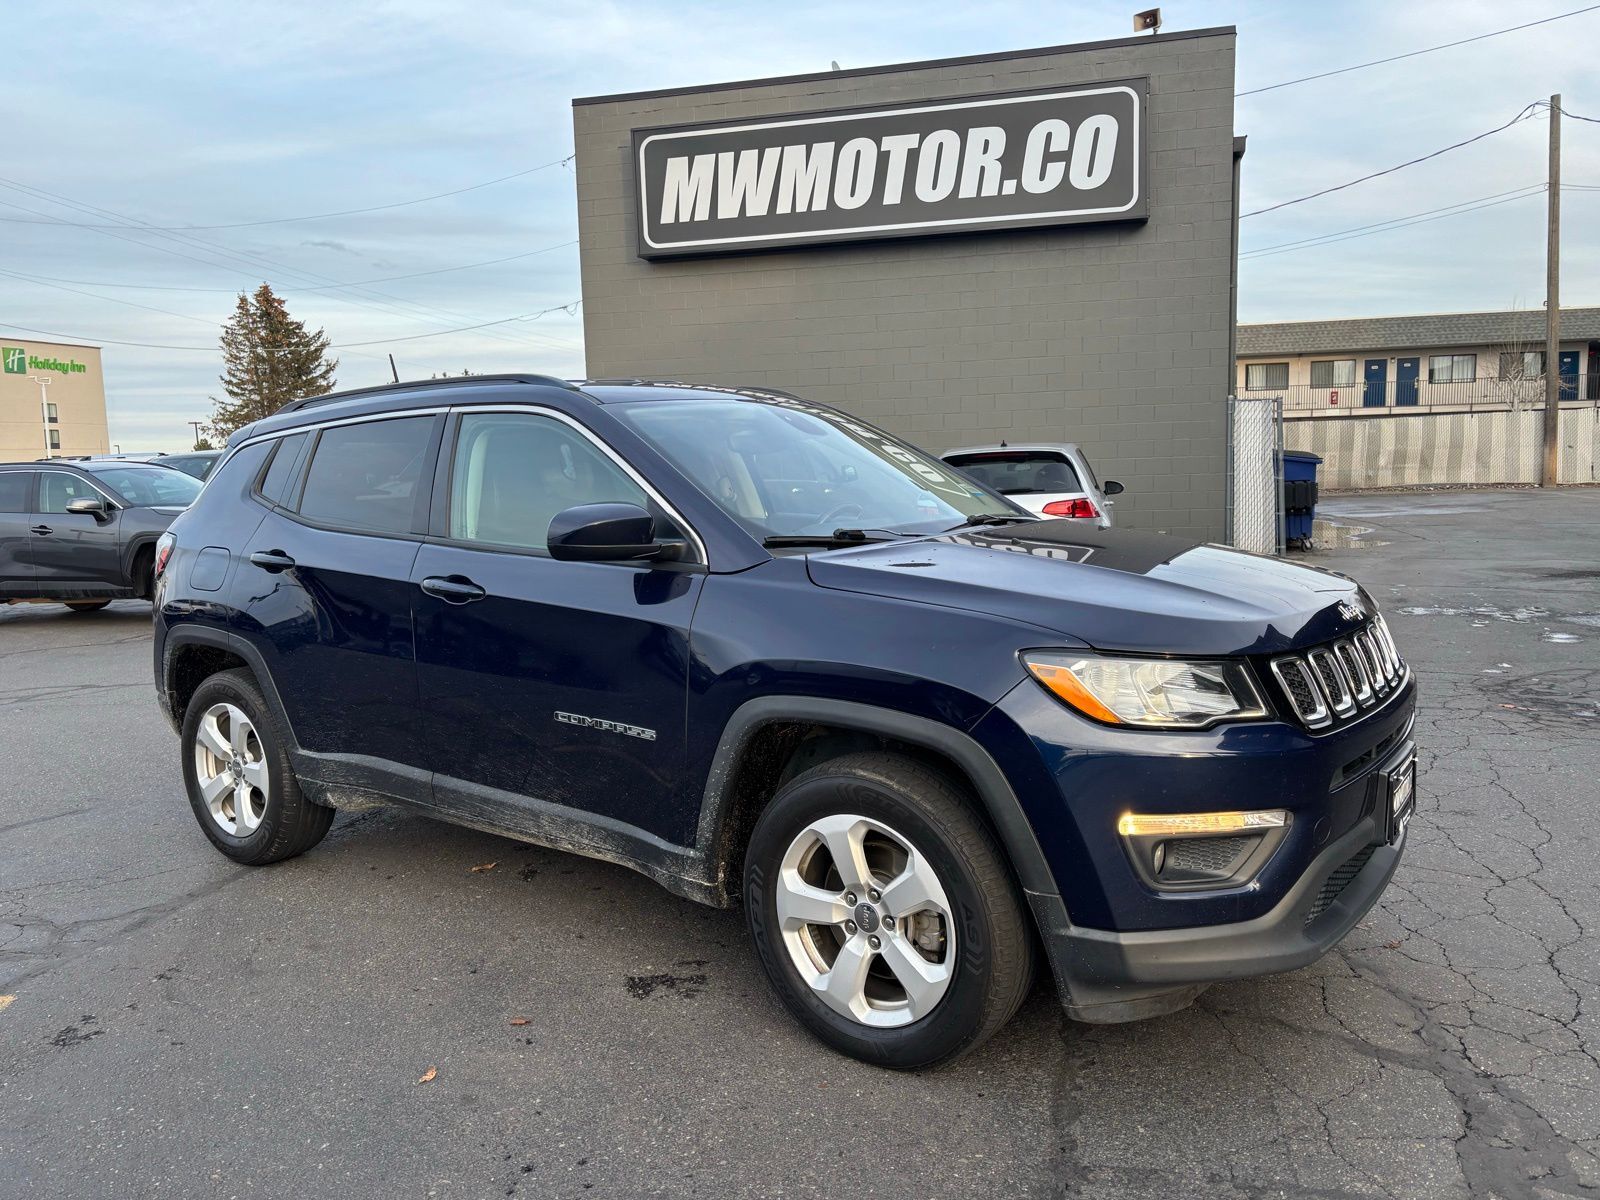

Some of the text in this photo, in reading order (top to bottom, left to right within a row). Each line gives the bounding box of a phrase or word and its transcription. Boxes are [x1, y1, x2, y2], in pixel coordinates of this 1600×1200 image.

[660, 114, 1119, 224] MWMOTOR.CO
[28, 355, 86, 374] Holiday Inn
[553, 711, 657, 741] COMPASS
